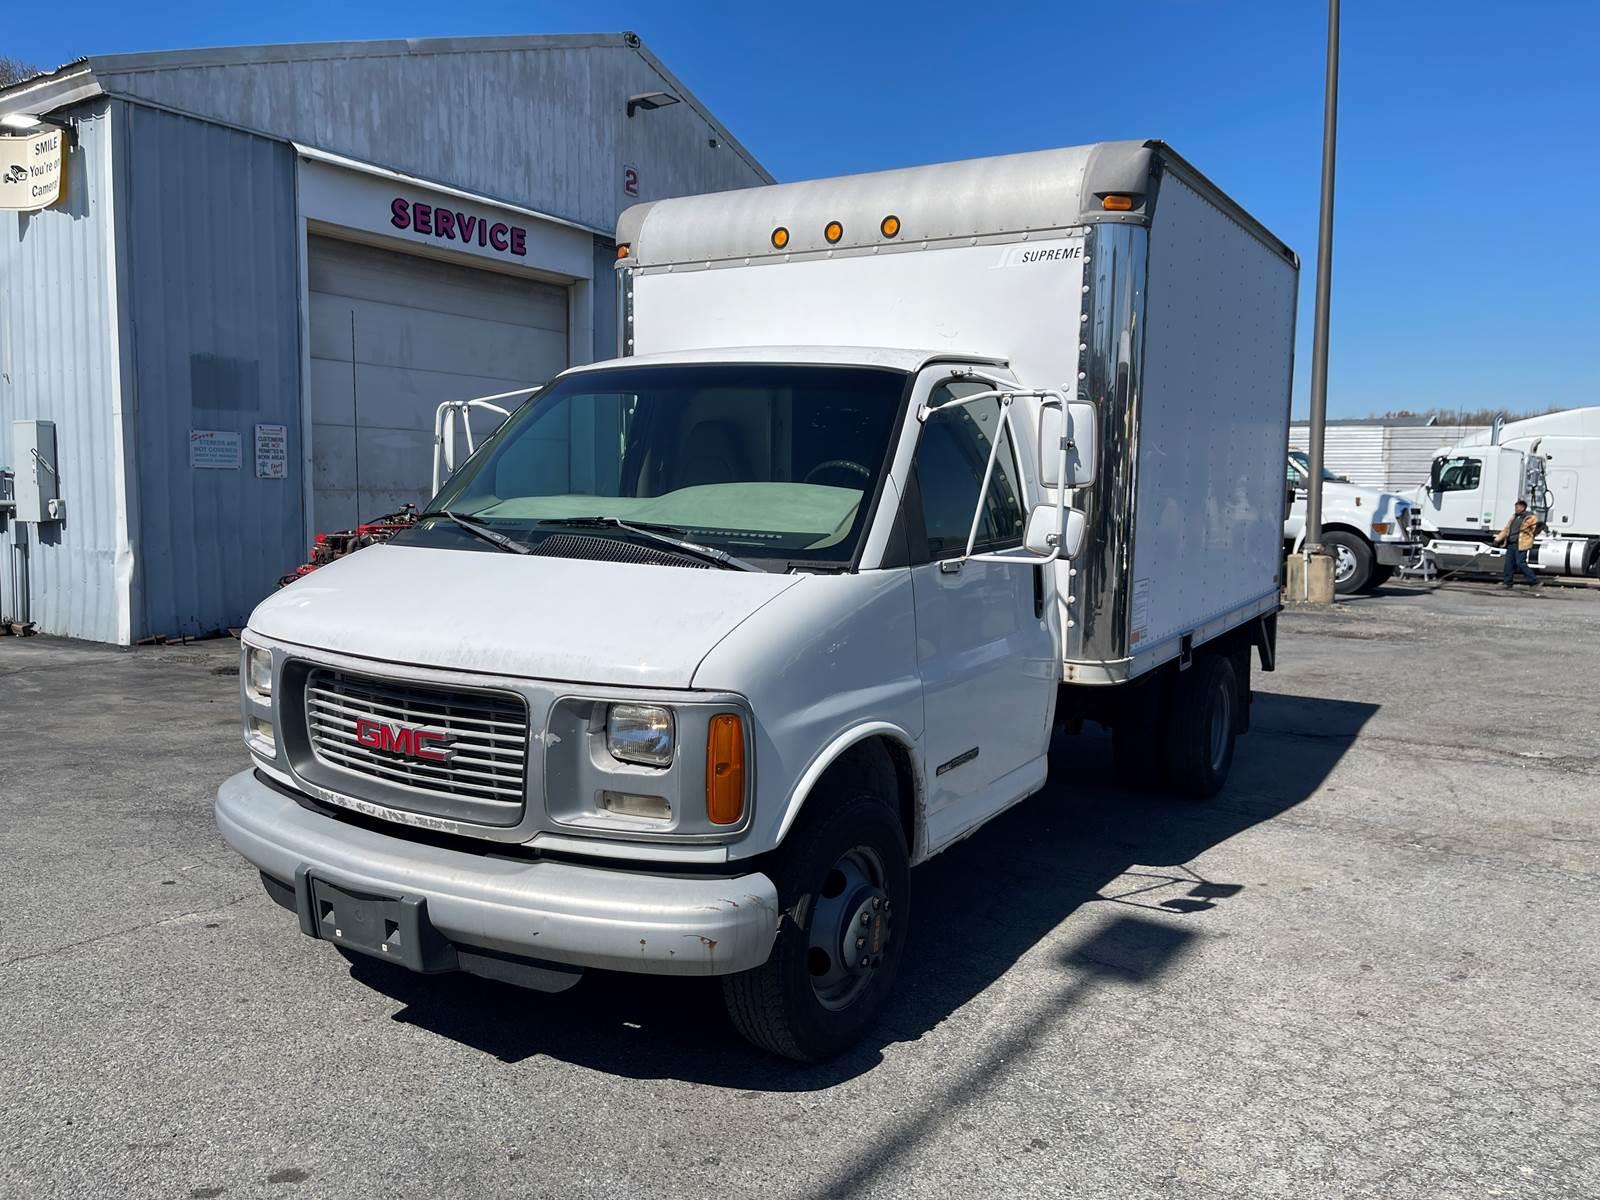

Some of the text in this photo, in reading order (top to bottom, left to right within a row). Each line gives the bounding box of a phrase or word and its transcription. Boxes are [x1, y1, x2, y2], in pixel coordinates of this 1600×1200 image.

[35, 136, 58, 155] SMILE
[29, 161, 53, 178] You're
[624, 168, 638, 194] 2
[390, 198, 527, 257] SERVICE
[1022, 246, 1082, 263] SUPREME
[356, 717, 455, 761] GMC
